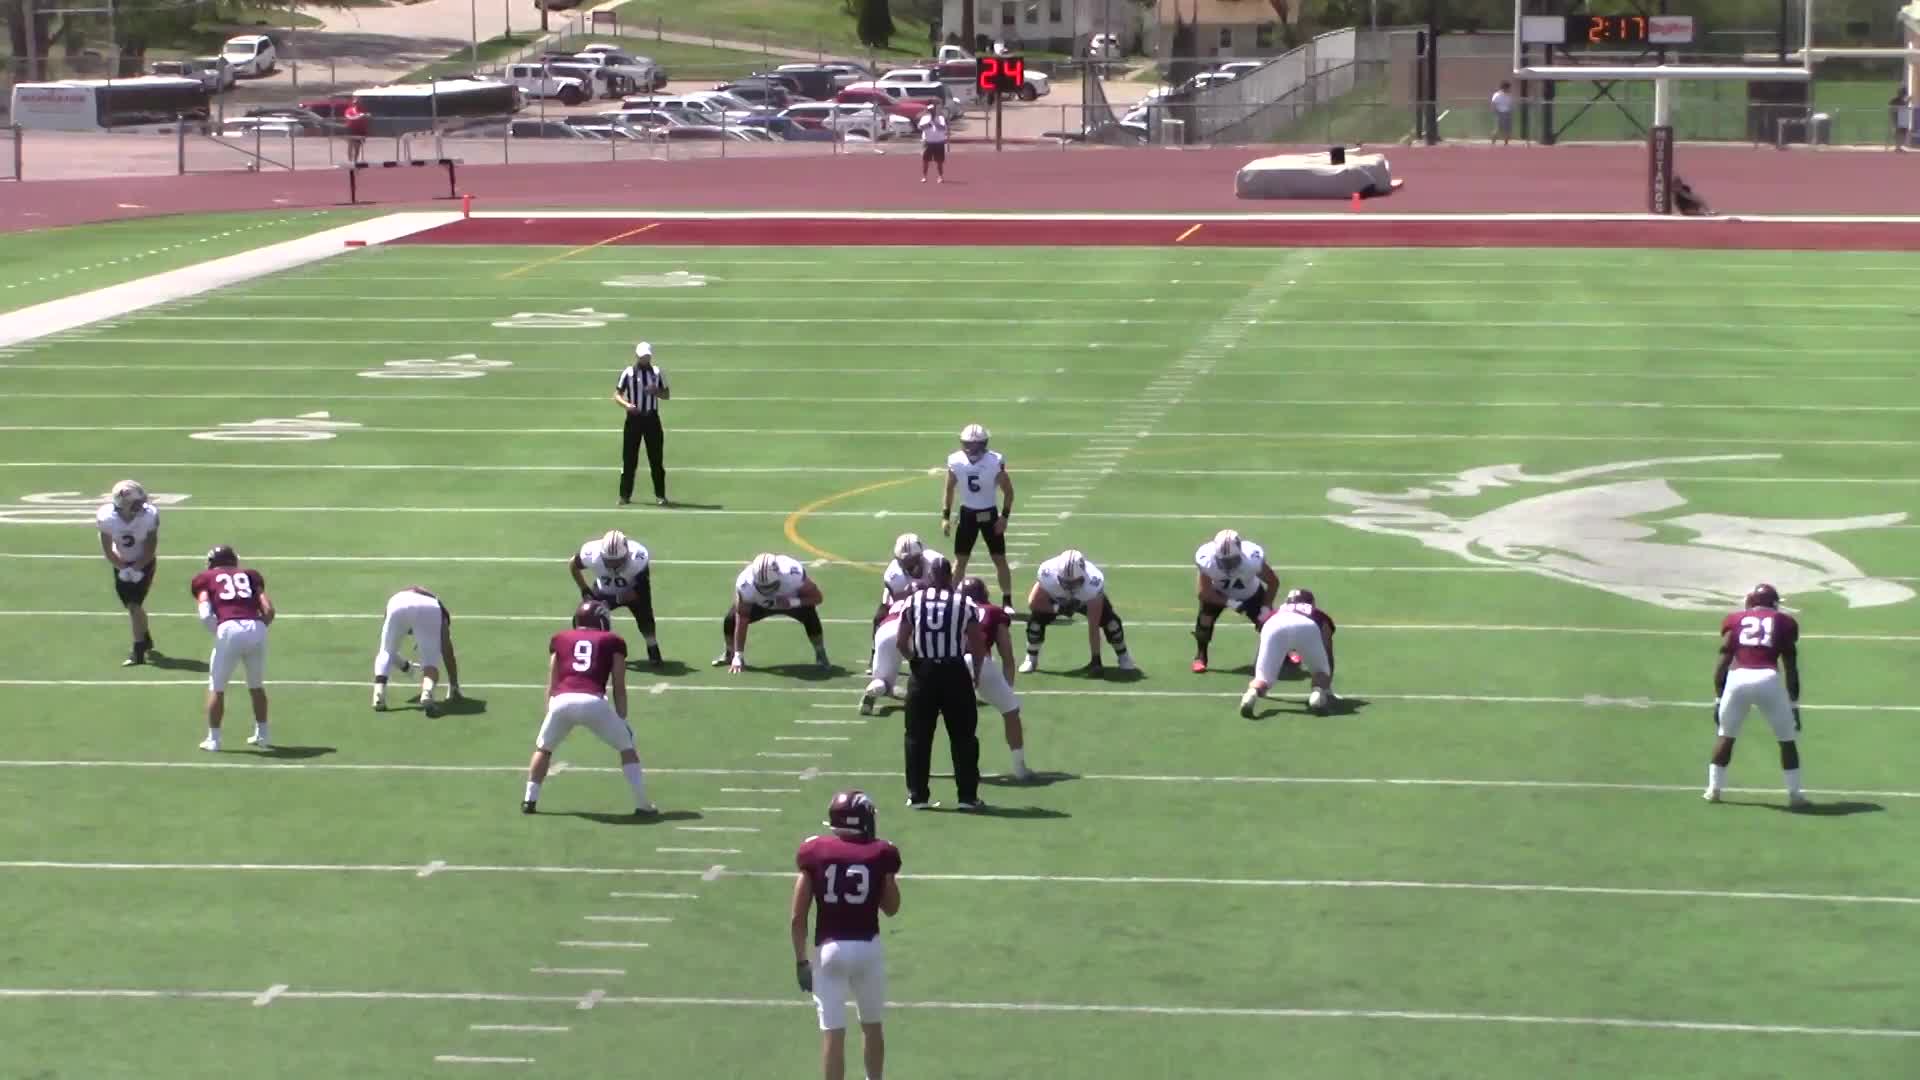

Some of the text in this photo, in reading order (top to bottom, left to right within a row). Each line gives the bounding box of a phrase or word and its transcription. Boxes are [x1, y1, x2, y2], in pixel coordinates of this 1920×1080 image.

[1589, 15, 1646, 42] 2:17
[979, 58, 1023, 89] 24
[215, 572, 253, 601] 39
[925, 601, 947, 630] U
[1738, 615, 1774, 647] 21
[571, 639, 593, 672] 9
[823, 863, 870, 905] 13
